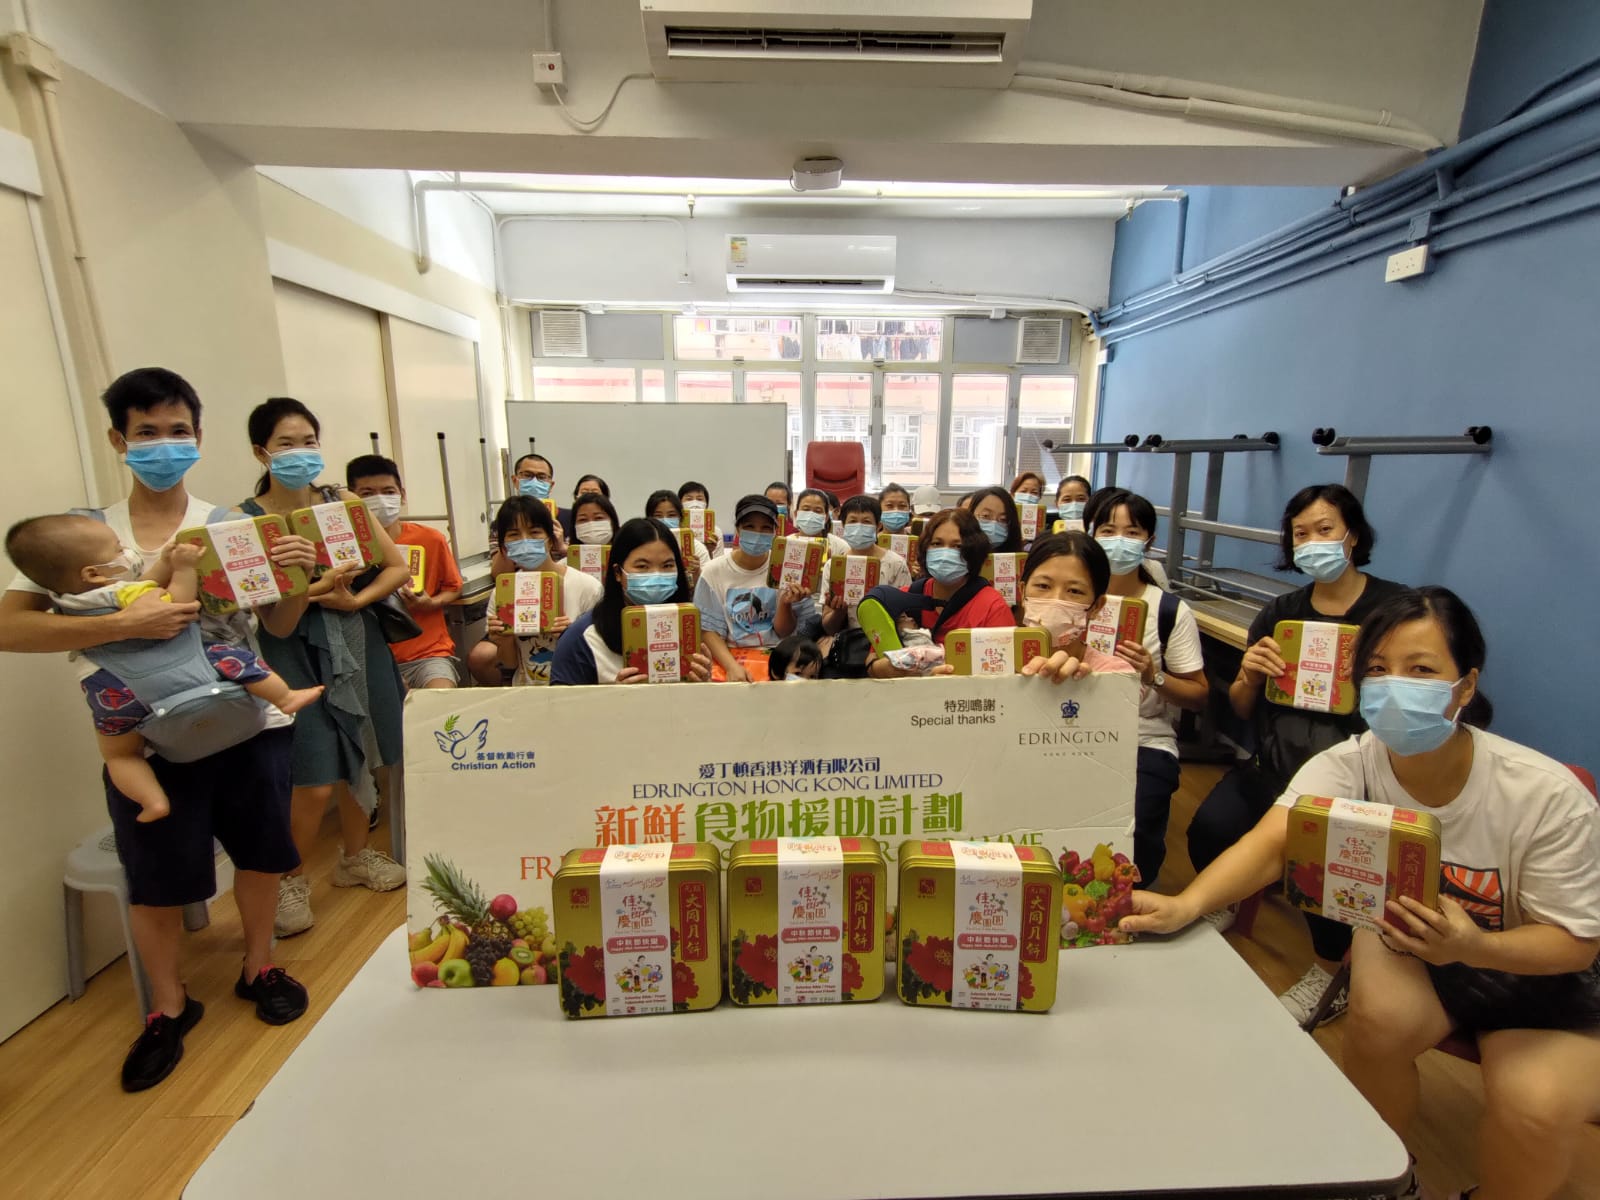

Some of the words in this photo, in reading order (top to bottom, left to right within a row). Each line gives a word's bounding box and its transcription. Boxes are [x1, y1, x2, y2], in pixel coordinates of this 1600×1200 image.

[911, 714, 954, 728] Special
[957, 713, 996, 725] thanks
[1018, 730, 1119, 745] EDRINGTON
[451, 762, 498, 771] Christian
[502, 761, 536, 769] Action
[698, 756, 881, 779] 愛丁頓香港洋酒有限公司
[632, 780, 747, 799] EDRINGTON
[752, 777, 808, 795] HONG
[813, 775, 870, 792] KONG
[874, 773, 943, 790] LIMITED
[594, 791, 963, 848] 新鮮食物援助計劃
